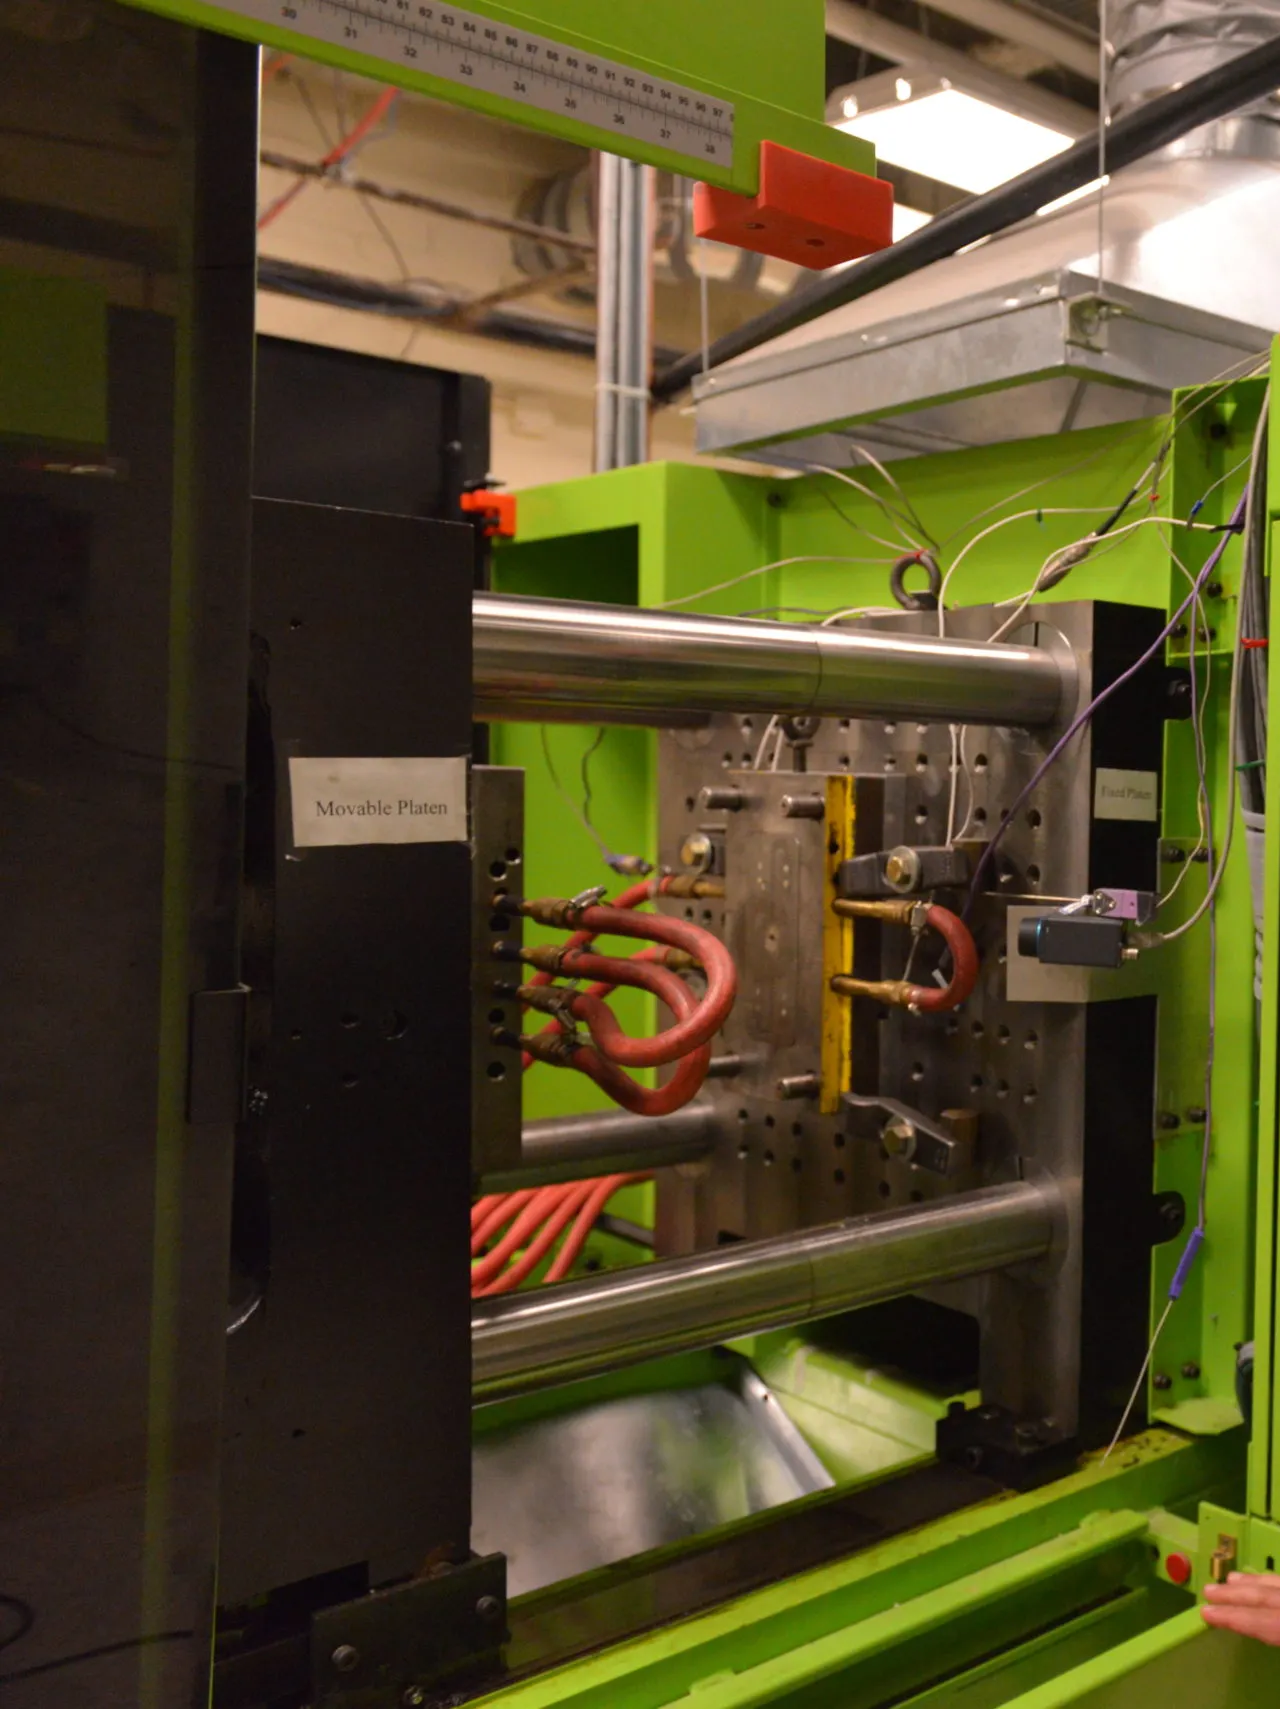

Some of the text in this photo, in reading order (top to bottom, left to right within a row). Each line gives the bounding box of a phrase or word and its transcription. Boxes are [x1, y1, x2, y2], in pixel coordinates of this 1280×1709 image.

[344, 26, 357, 39] 31
[404, 45, 417, 58] 32
[460, 63, 473, 76] 33
[513, 80, 526, 93] 34
[660, 128, 671, 139] 37
[419, 7, 432, 19] 82
[441, 14, 455, 26] 83
[463, 21, 476, 33] 84
[484, 28, 498, 41] 85
[506, 35, 518, 48] 86
[526, 43, 539, 55] 87
[546, 50, 559, 62] 88
[566, 56, 579, 69] 89
[585, 63, 598, 75] 90
[605, 69, 616, 81] 91
[624, 76, 635, 88] 92
[642, 83, 654, 95] 93
[660, 89, 671, 100] 94
[678, 95, 689, 106] 95
[713, 107, 723, 118] 97
[315, 799, 448, 817] Movable Platen
